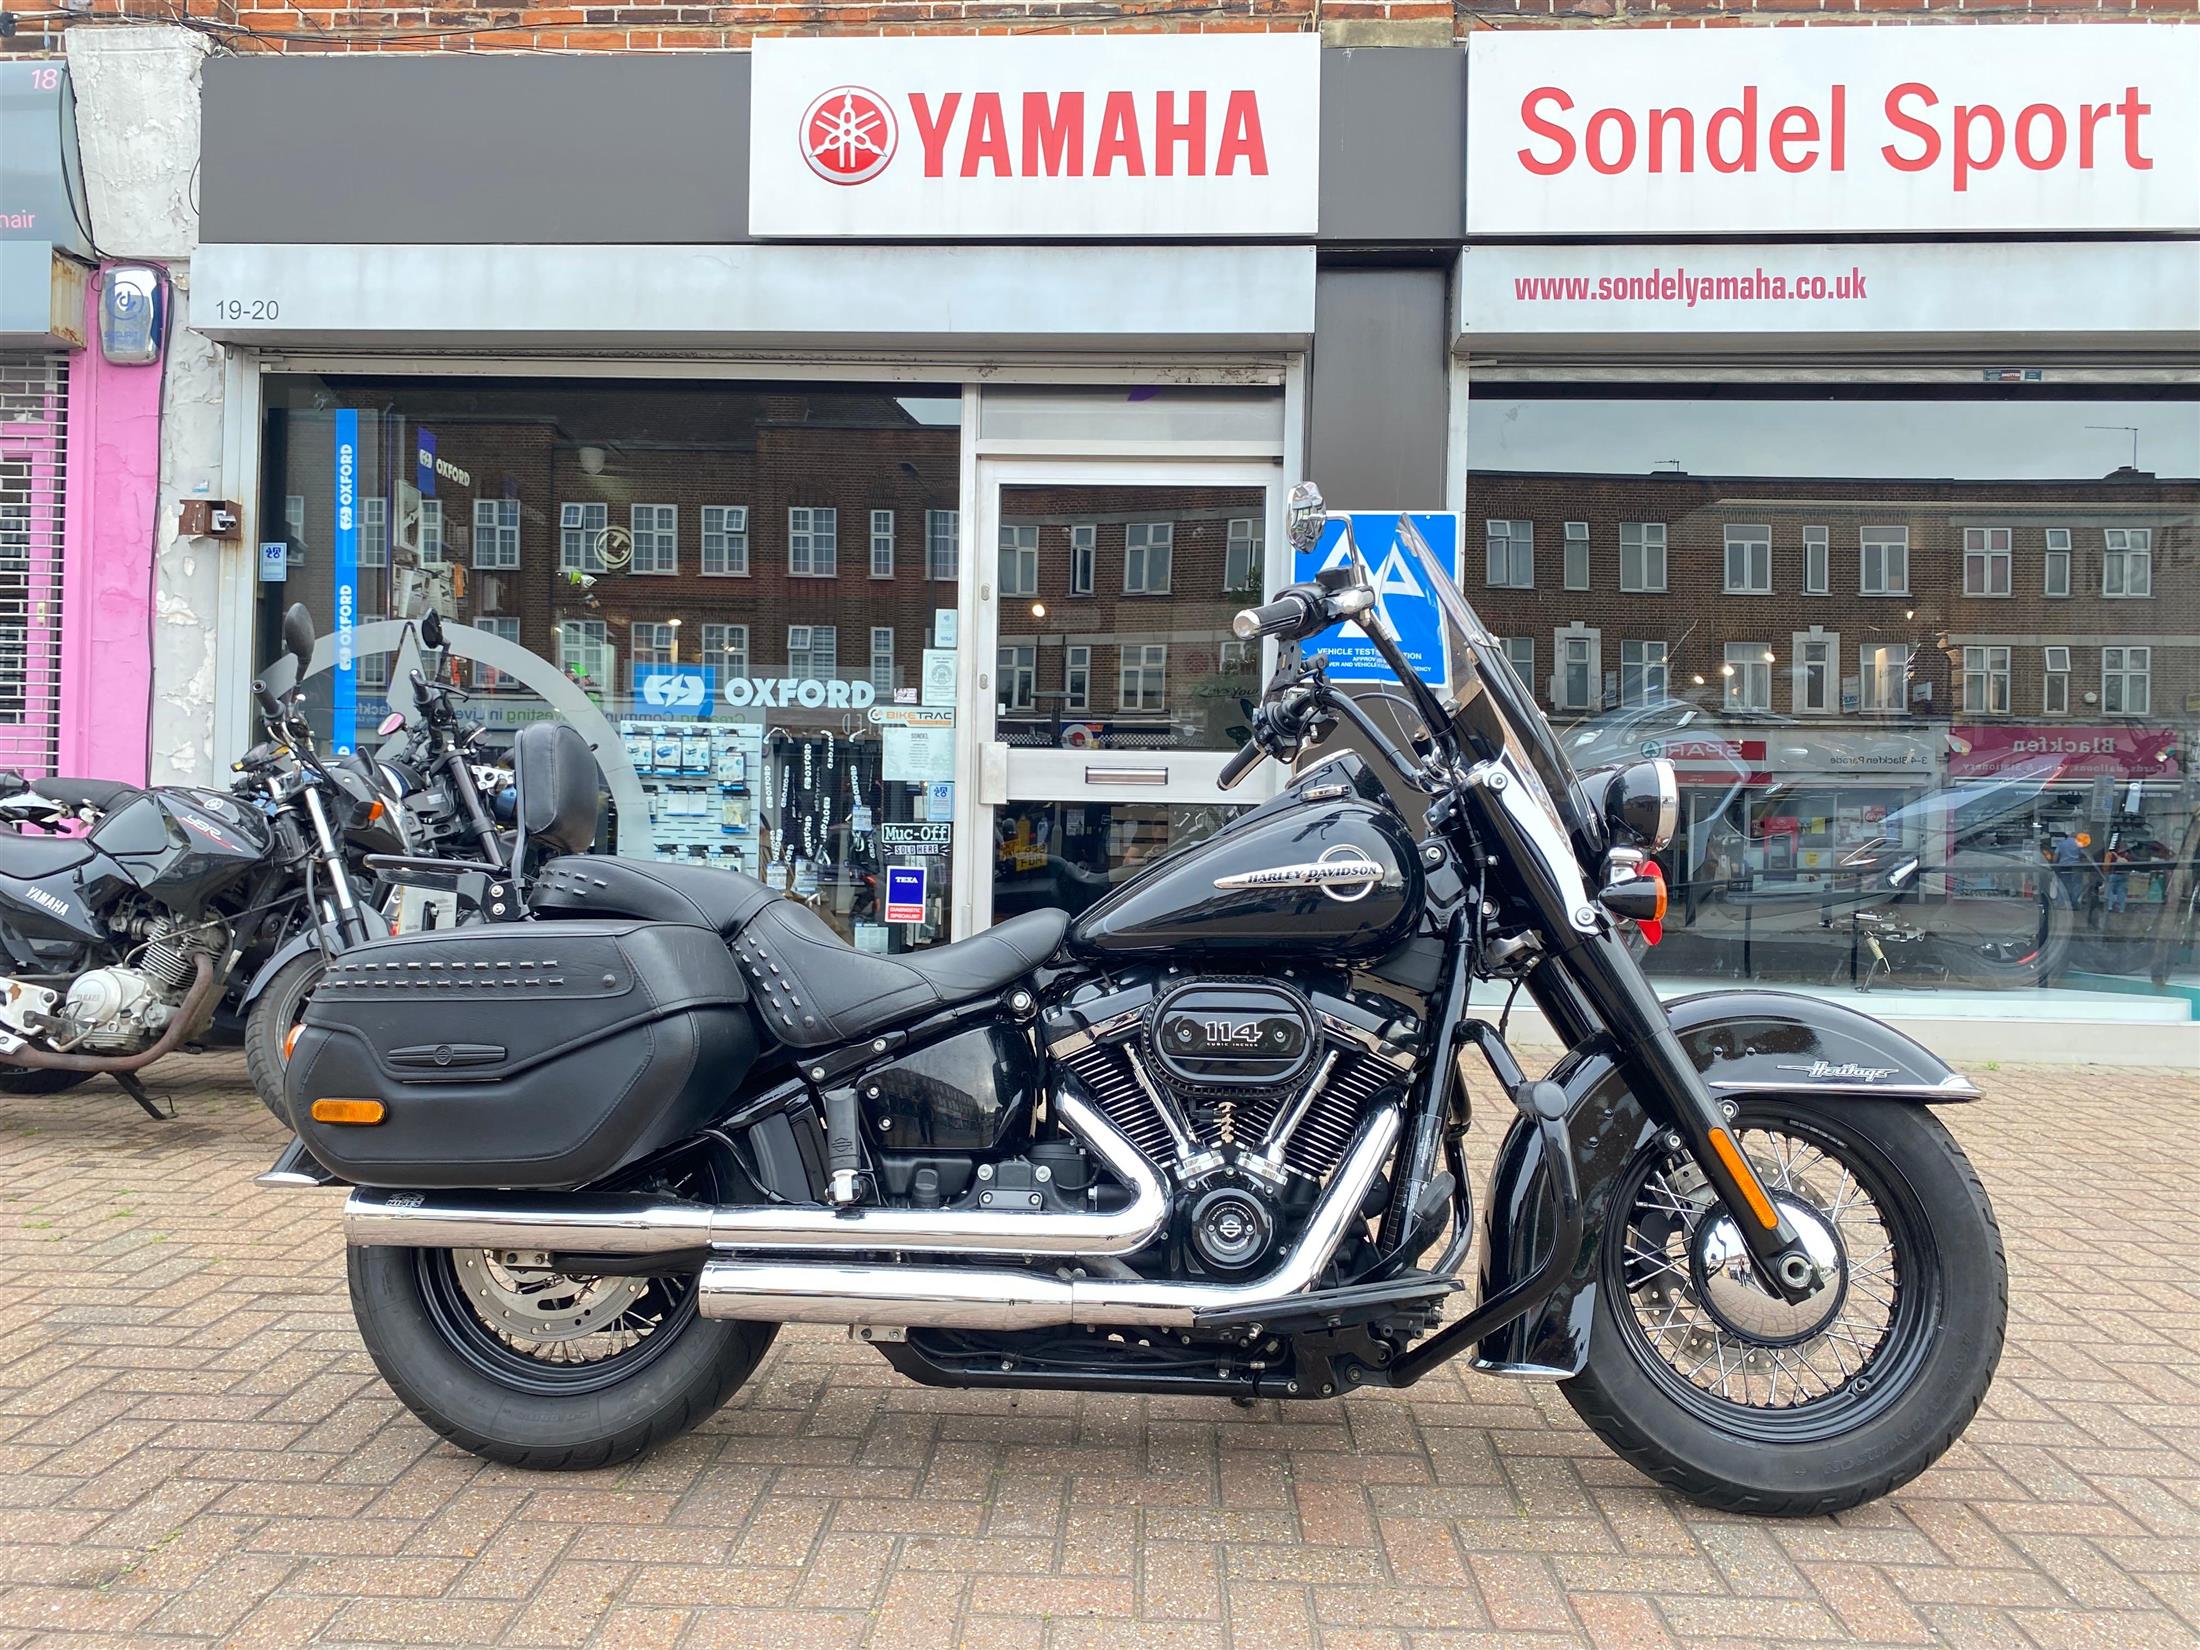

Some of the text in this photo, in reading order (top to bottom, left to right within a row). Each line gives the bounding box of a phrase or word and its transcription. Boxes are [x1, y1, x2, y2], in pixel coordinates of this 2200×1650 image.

[31, 69, 58, 89] 18
[908, 90, 1269, 178] YAMAHA
[1517, 82, 2154, 192] Sondel Sport
[1514, 267, 1868, 307] www.sondelyamaha.co.uk
[215, 300, 280, 321] 19-20
[340, 444, 353, 505] OXFORD
[436, 458, 470, 487] OXFORD
[339, 585, 352, 646] OXFORD
[724, 677, 876, 709] OXFORD
[886, 712, 952, 720] BIKETRAC
[803, 743, 812, 777] OXFORD
[764, 765, 773, 796] OXFORD
[850, 765, 860, 795] OXFORD
[803, 816, 812, 848] OXFORD
[885, 826, 947, 840] Muc-Off
[895, 845, 938, 854] SOLD HERE
[1248, 866, 1377, 884] HARLEY-DAVIDSON
[25, 886, 70, 917] YAMAHA
[1205, 1021, 1263, 1042] 114
[1804, 1060, 1890, 1082] Heritage
